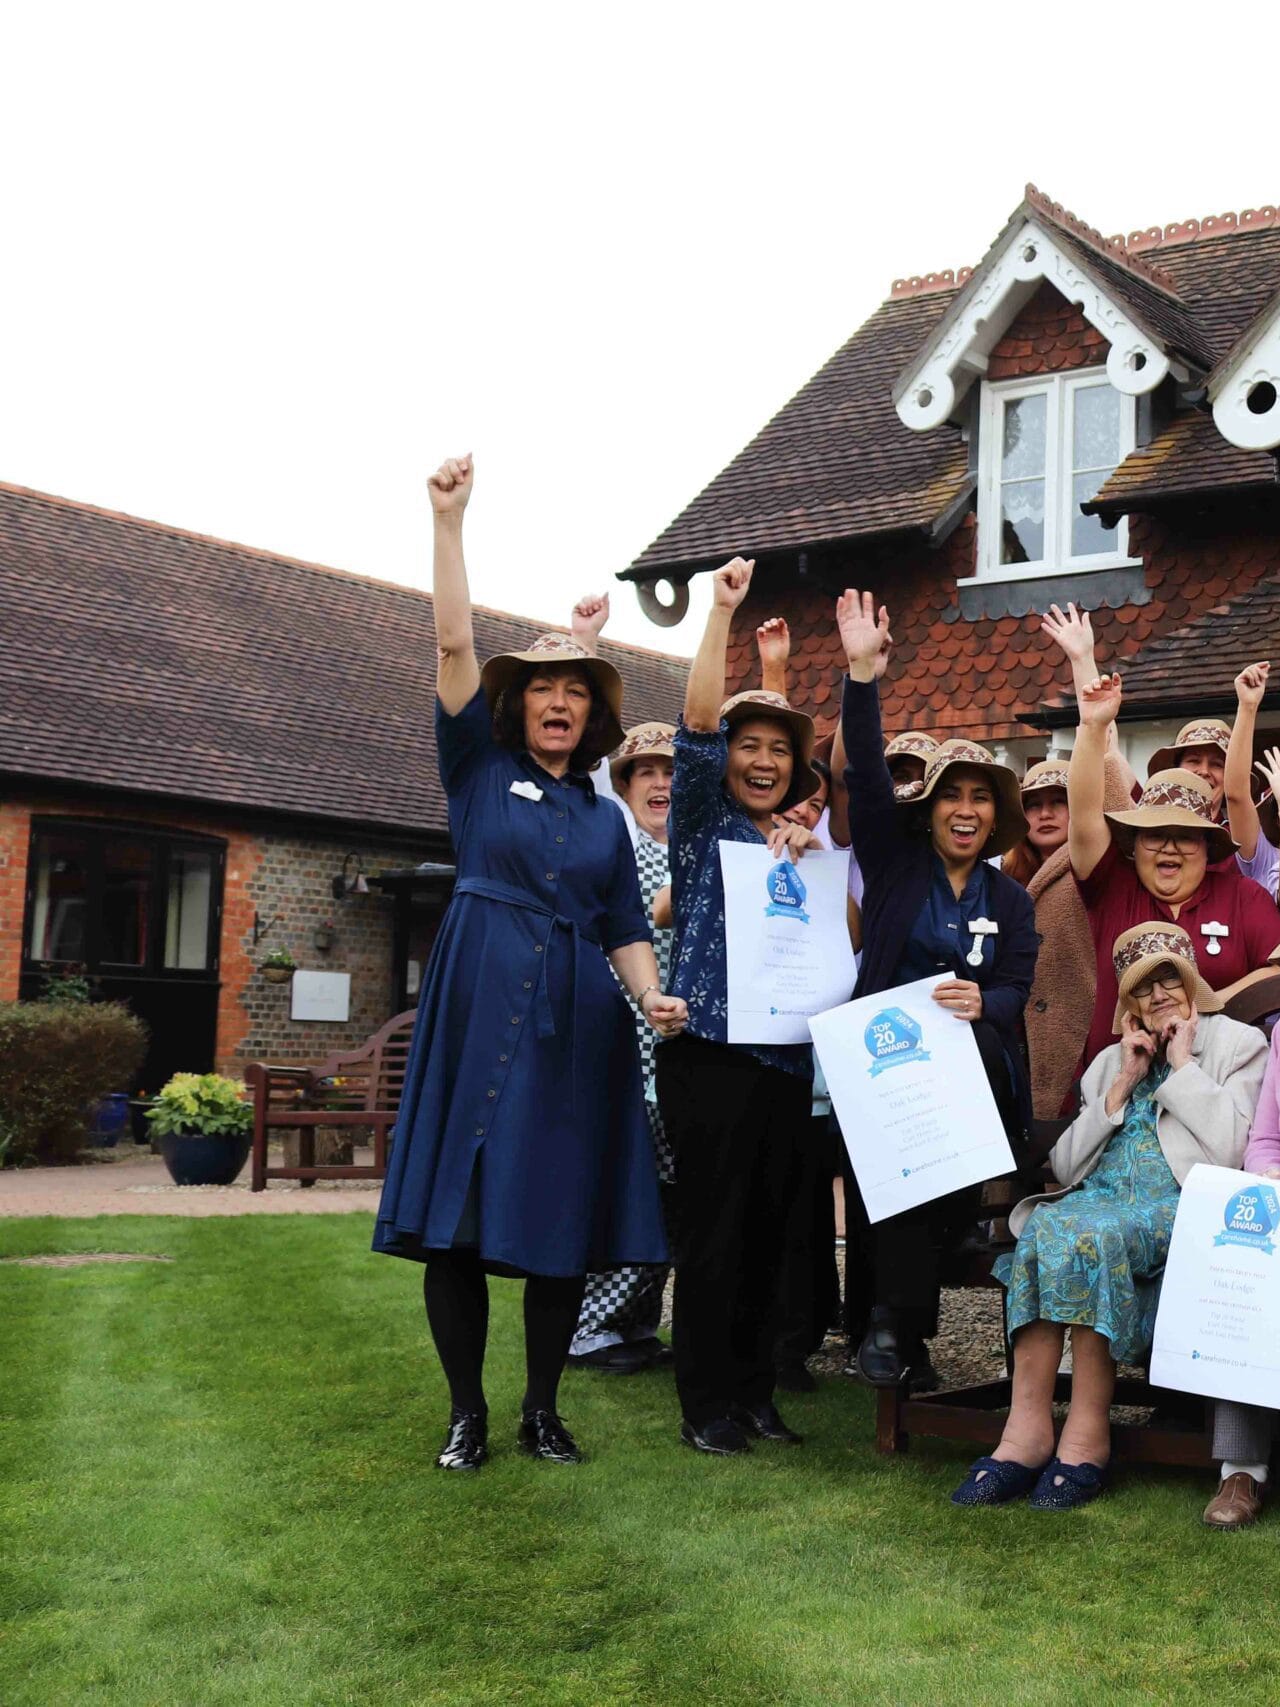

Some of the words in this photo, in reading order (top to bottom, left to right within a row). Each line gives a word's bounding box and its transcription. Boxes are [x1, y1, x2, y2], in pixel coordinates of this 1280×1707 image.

[774, 871, 787, 881] TOP
[774, 880, 788, 896] 20
[773, 893, 796, 905] AWARD
[871, 1022, 892, 1034] TOP
[874, 1030, 896, 1048] 20
[876, 1040, 910, 1057] AWARD
[1239, 1195, 1258, 1206] TOP
[1233, 1204, 1256, 1222] 20
[1228, 1220, 1263, 1233] AWARD
